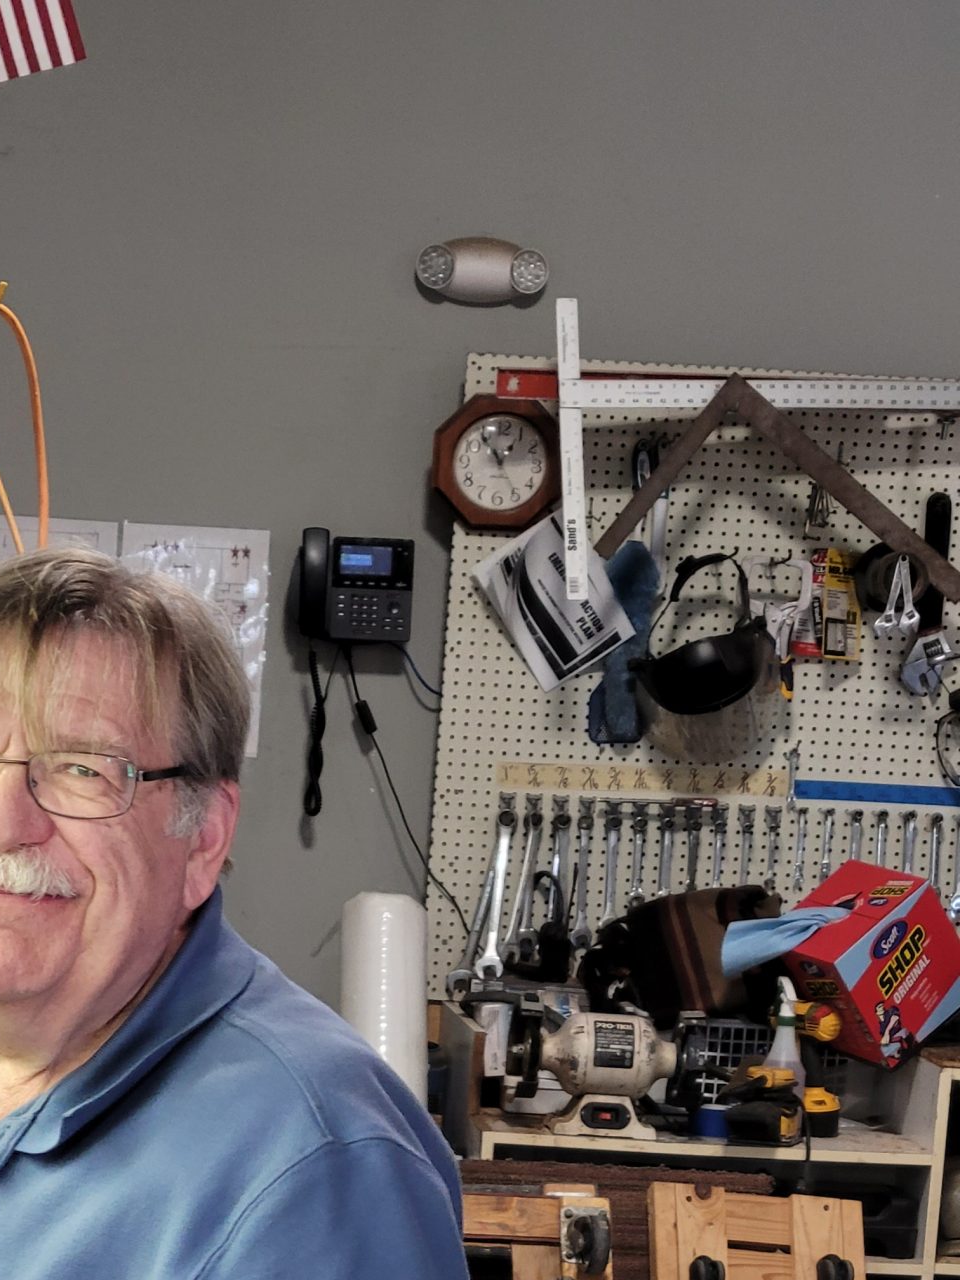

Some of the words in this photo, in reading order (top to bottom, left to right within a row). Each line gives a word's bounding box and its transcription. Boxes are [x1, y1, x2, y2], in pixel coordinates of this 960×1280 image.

[460, 455, 470, 469] 9
[531, 460, 542, 473] 3
[463, 472, 474, 487] 8
[477, 485, 487, 500] 7
[491, 491, 503, 505] 6
[567, 519, 577, 551] Sand's
[580, 600, 605, 633] ACTION
[576, 617, 595, 640] PLAN
[880, 925, 900, 951] Scott
[877, 925, 926, 997] SHOP
[894, 955, 931, 1005] ORIGINAL
